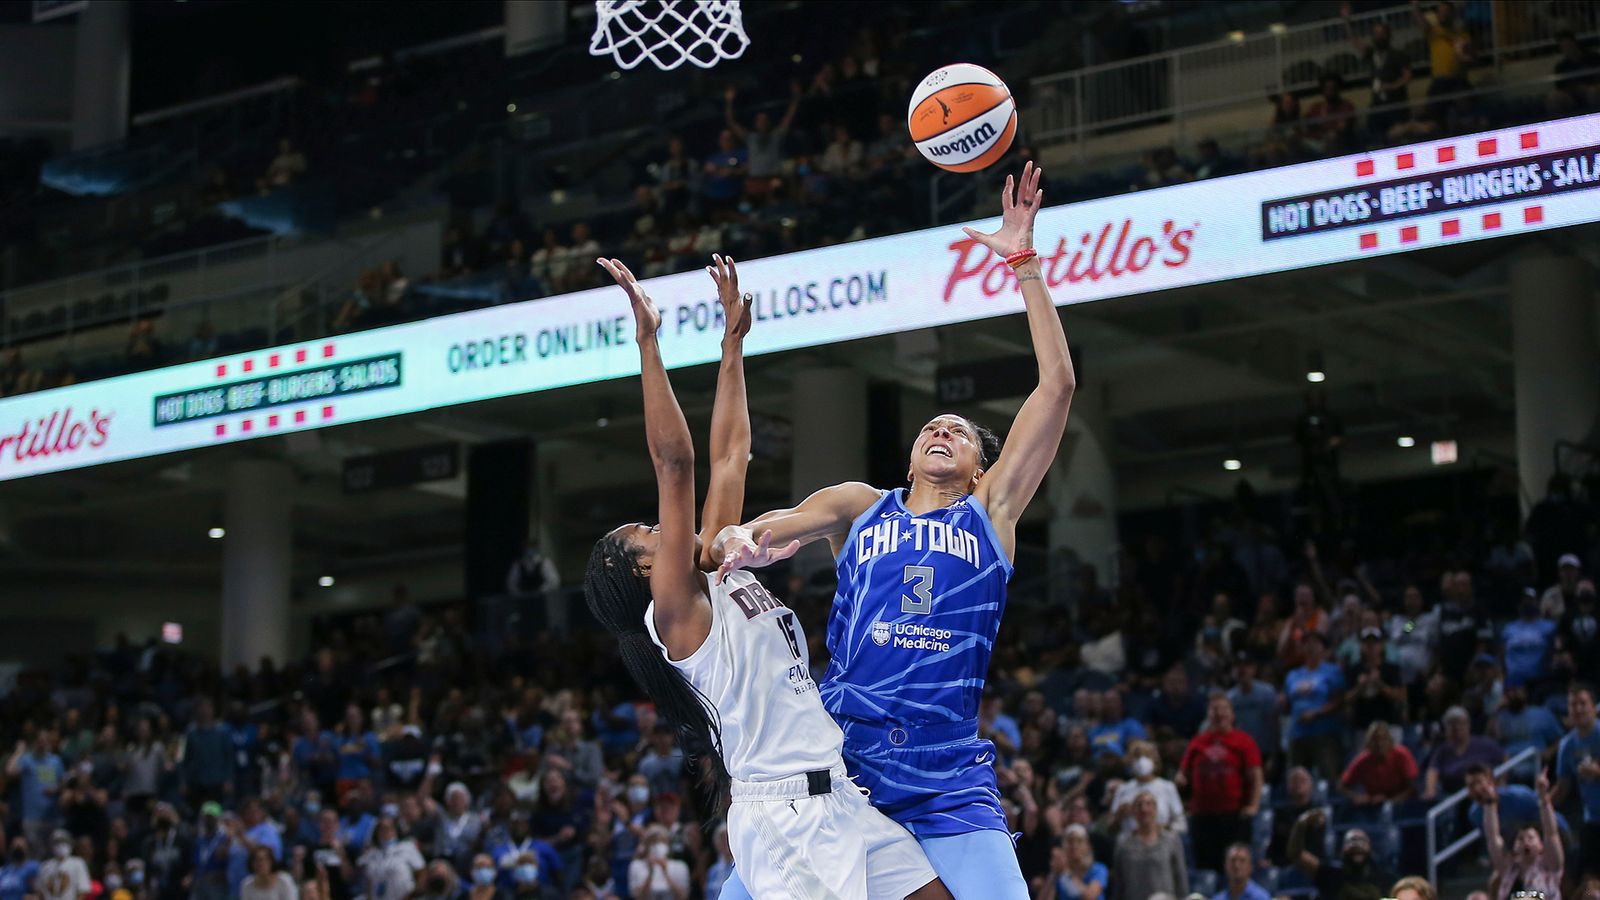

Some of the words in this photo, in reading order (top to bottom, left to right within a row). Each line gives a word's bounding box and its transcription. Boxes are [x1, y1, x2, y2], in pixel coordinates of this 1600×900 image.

[928, 122, 998, 157] Wilson
[1268, 201, 1311, 234] HOT
[1313, 191, 1372, 226] DOGS
[1379, 181, 1434, 216] BEEF
[1442, 163, 1541, 206] BURGERS
[943, 218, 1198, 303] Potillo's
[447, 336, 528, 375] ORDER
[536, 315, 628, 359] ONLINE
[678, 269, 888, 336] PORLLOS.COM
[157, 396, 184, 422] HOT
[858, 519, 900, 567] CHI
[910, 518, 981, 570] TOWN
[901, 565, 935, 616] 3
[893, 636, 951, 653] Medicine
[895, 623, 952, 640] UChicago
